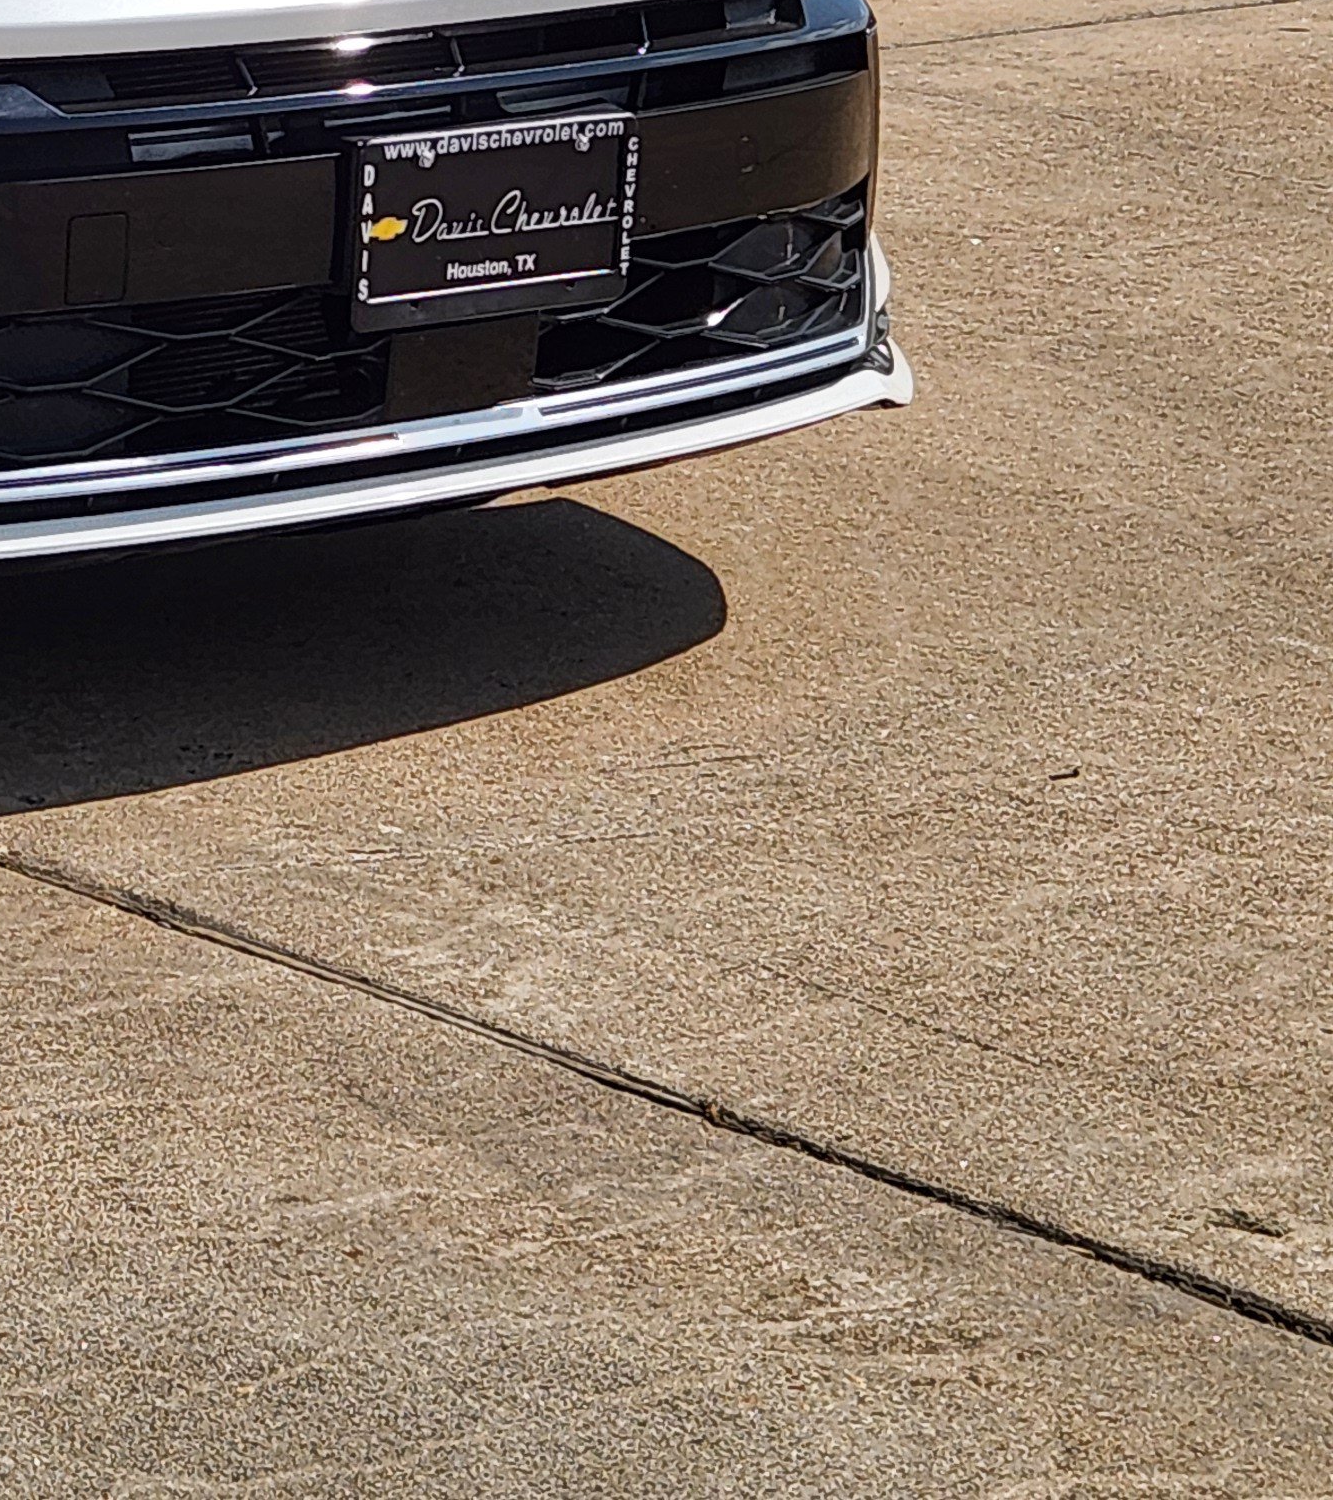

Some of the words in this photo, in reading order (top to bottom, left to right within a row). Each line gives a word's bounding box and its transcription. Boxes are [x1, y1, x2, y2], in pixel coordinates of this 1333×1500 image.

[384, 120, 624, 159] www.davischevrolet.com
[358, 163, 376, 301] DAVIS
[411, 198, 490, 243] Davis
[490, 189, 619, 235] Chevrolet
[619, 136, 640, 276] CHEVROLET
[446, 258, 511, 280] Houston,
[515, 253, 537, 272] TX
